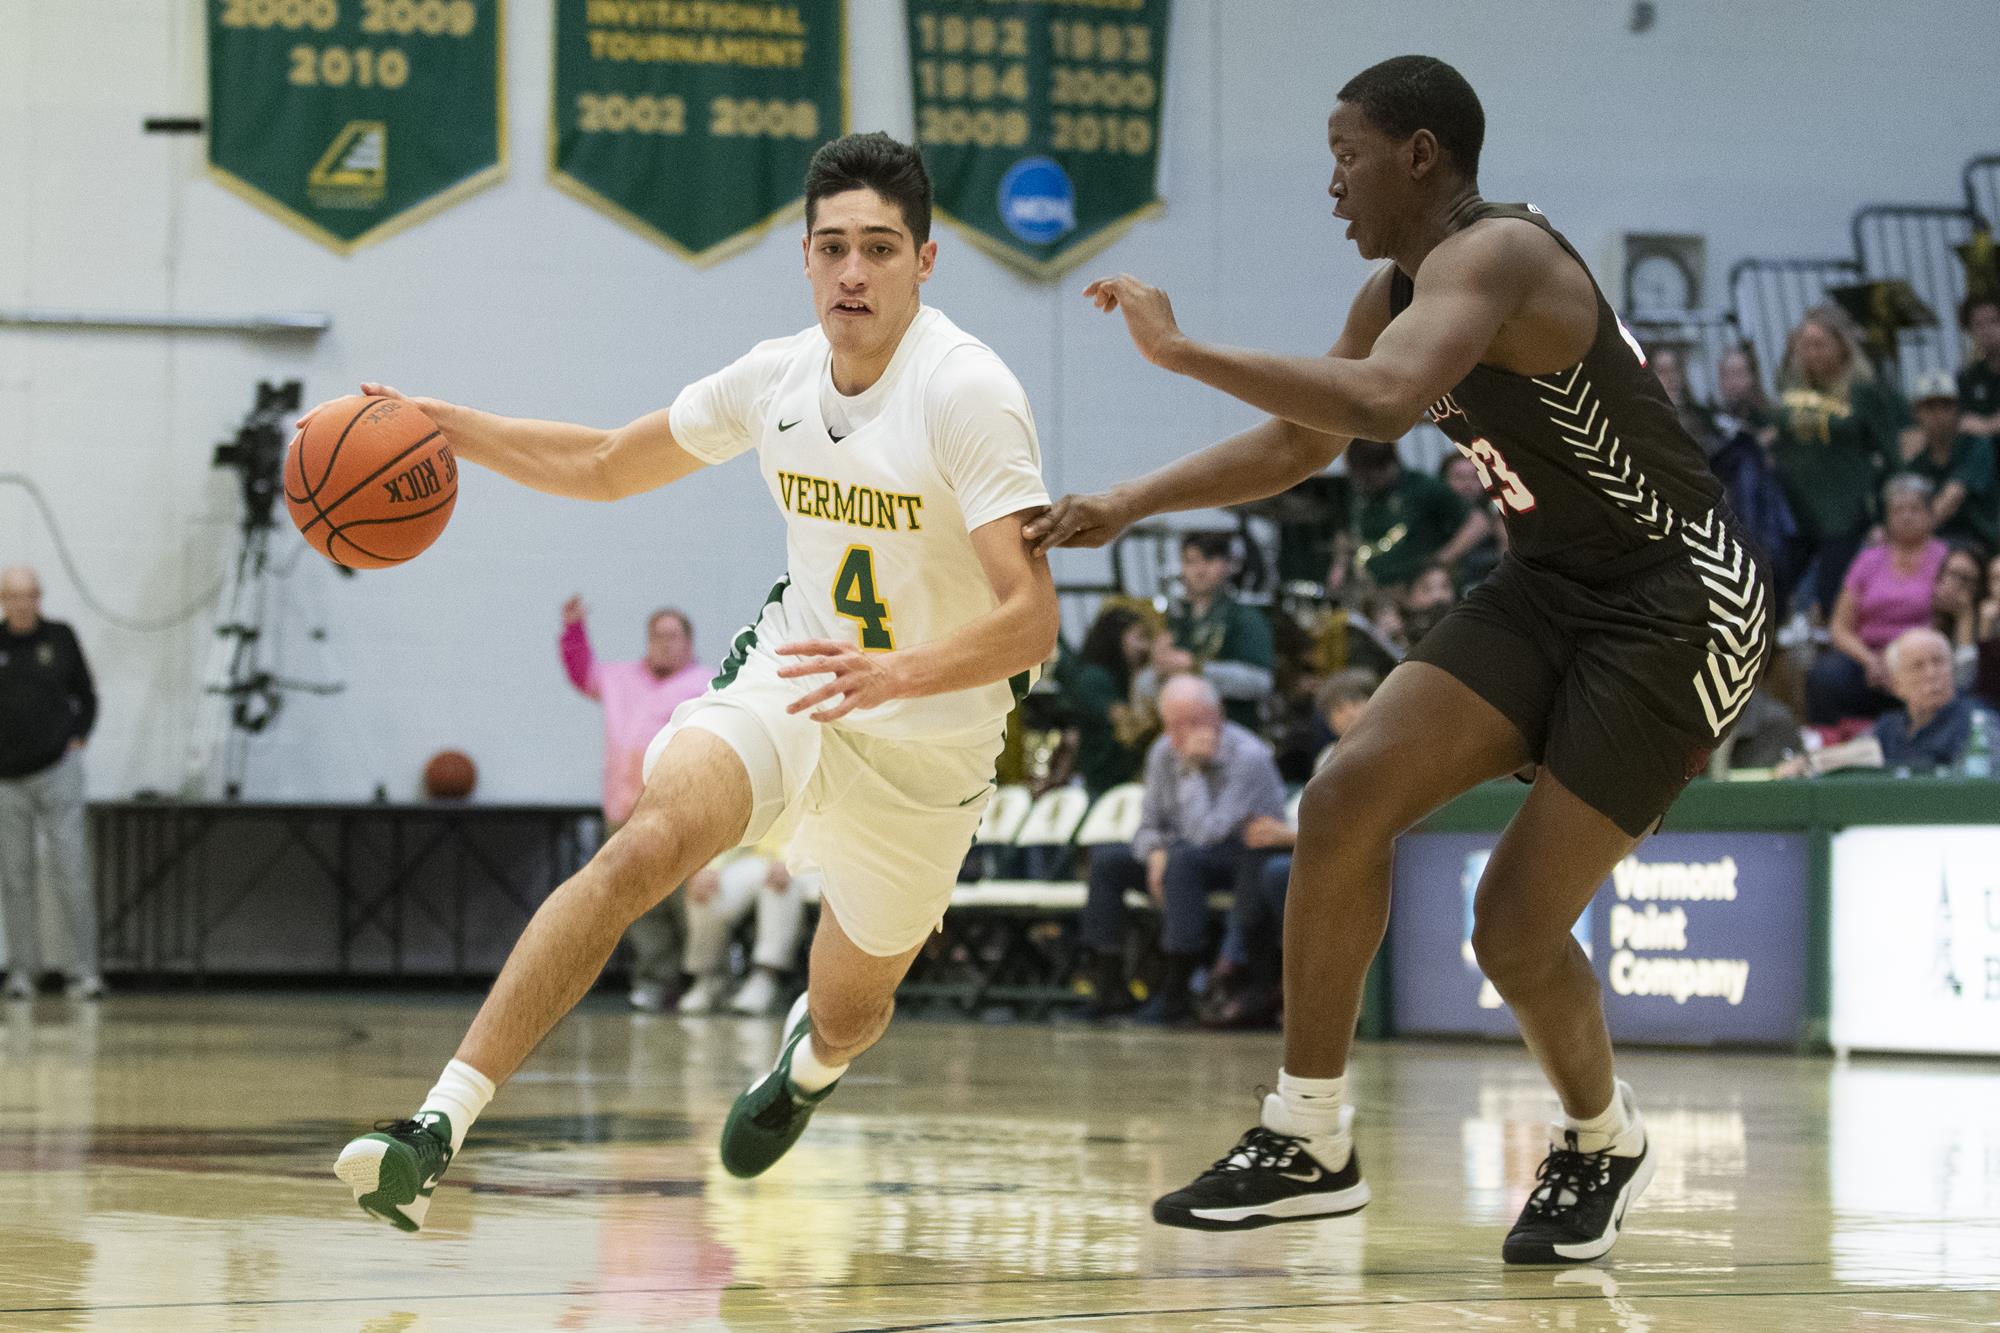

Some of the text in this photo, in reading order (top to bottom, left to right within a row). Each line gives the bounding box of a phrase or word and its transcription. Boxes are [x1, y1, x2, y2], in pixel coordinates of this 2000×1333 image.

[289, 46, 408, 89] 2010
[588, 31, 805, 68] TOURNAMENT
[577, 92, 686, 135] 2002
[383, 457, 441, 503] ROCK
[777, 470, 923, 531] VERMONT
[831, 543, 896, 652] 4
[1612, 855, 1739, 900] Vermont
[1610, 904, 1688, 950] Paint
[1609, 950, 1749, 1005] Company
